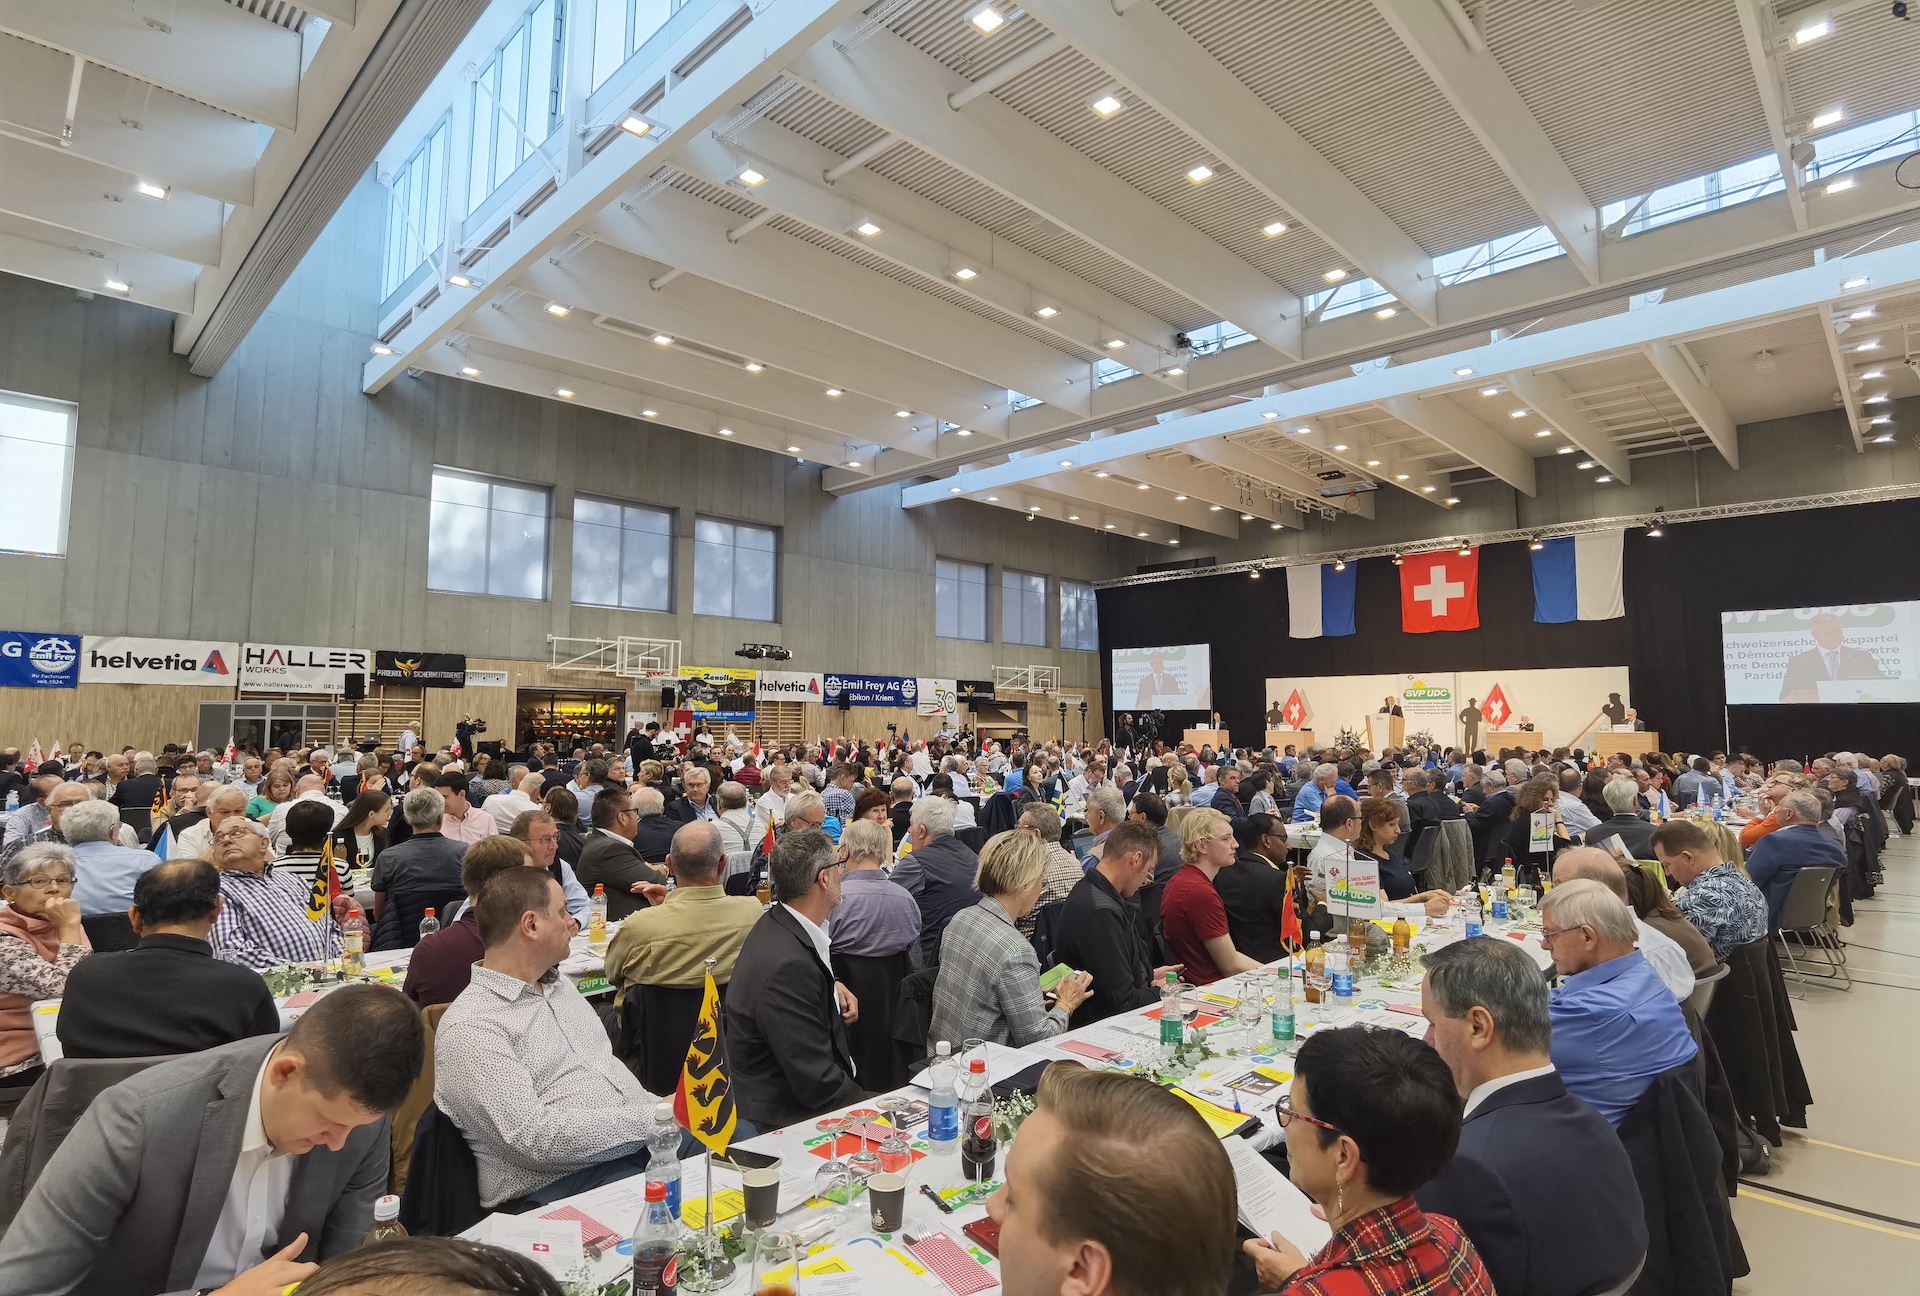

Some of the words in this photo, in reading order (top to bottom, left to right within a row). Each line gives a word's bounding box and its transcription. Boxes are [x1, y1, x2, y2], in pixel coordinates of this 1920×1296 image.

[1724, 638, 1817, 650] chweizerische
[1843, 634, 1899, 645] kspartei
[0, 641, 23, 658] G
[29, 652, 52, 660] Emil
[54, 653, 77, 661] Frey
[91, 650, 197, 671] helvetia
[245, 647, 366, 670] HALLER
[245, 666, 287, 674] WORKS
[413, 671, 464, 679] SICHERHEITSDIENST
[1113, 666, 1153, 674] chweizerische
[1744, 671, 1787, 681] Partid
[243, 681, 313, 690] www.hallerworks.ch
[760, 681, 806, 692] helvetia
[842, 680, 863, 690] Emil
[866, 681, 885, 692] Frey
[887, 682, 900, 691] AG
[849, 693, 870, 701] Ebikon
[875, 695, 894, 703] Kriens
[1406, 690, 1426, 698] SVP
[1427, 689, 1448, 697] UDC
[935, 689, 957, 714] 30
[1350, 892, 1372, 900] UDC
[579, 979, 599, 990] SVP
